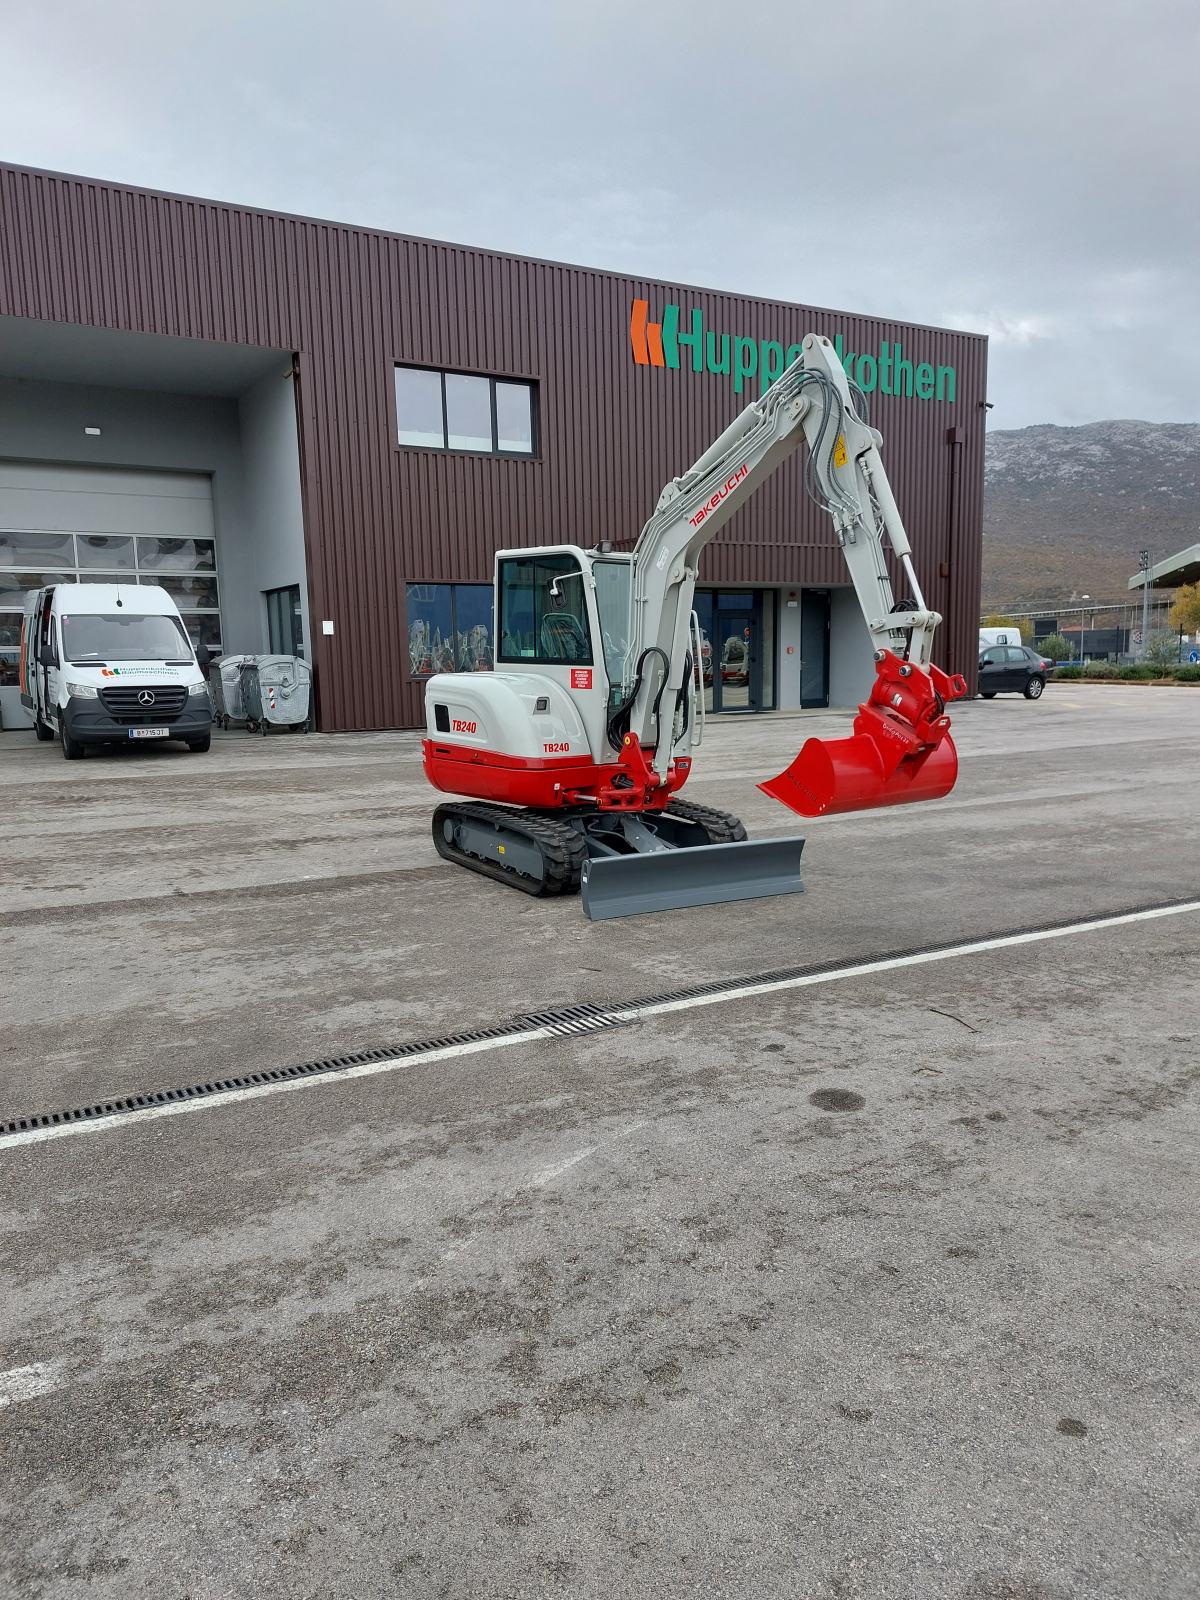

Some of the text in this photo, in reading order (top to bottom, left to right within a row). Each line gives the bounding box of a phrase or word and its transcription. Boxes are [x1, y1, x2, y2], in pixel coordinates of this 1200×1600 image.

[662, 304, 955, 402] Huppkothen
[689, 463, 748, 527] TAKEUCHI
[452, 719, 477, 733] TB240
[543, 742, 570, 753] TB240
